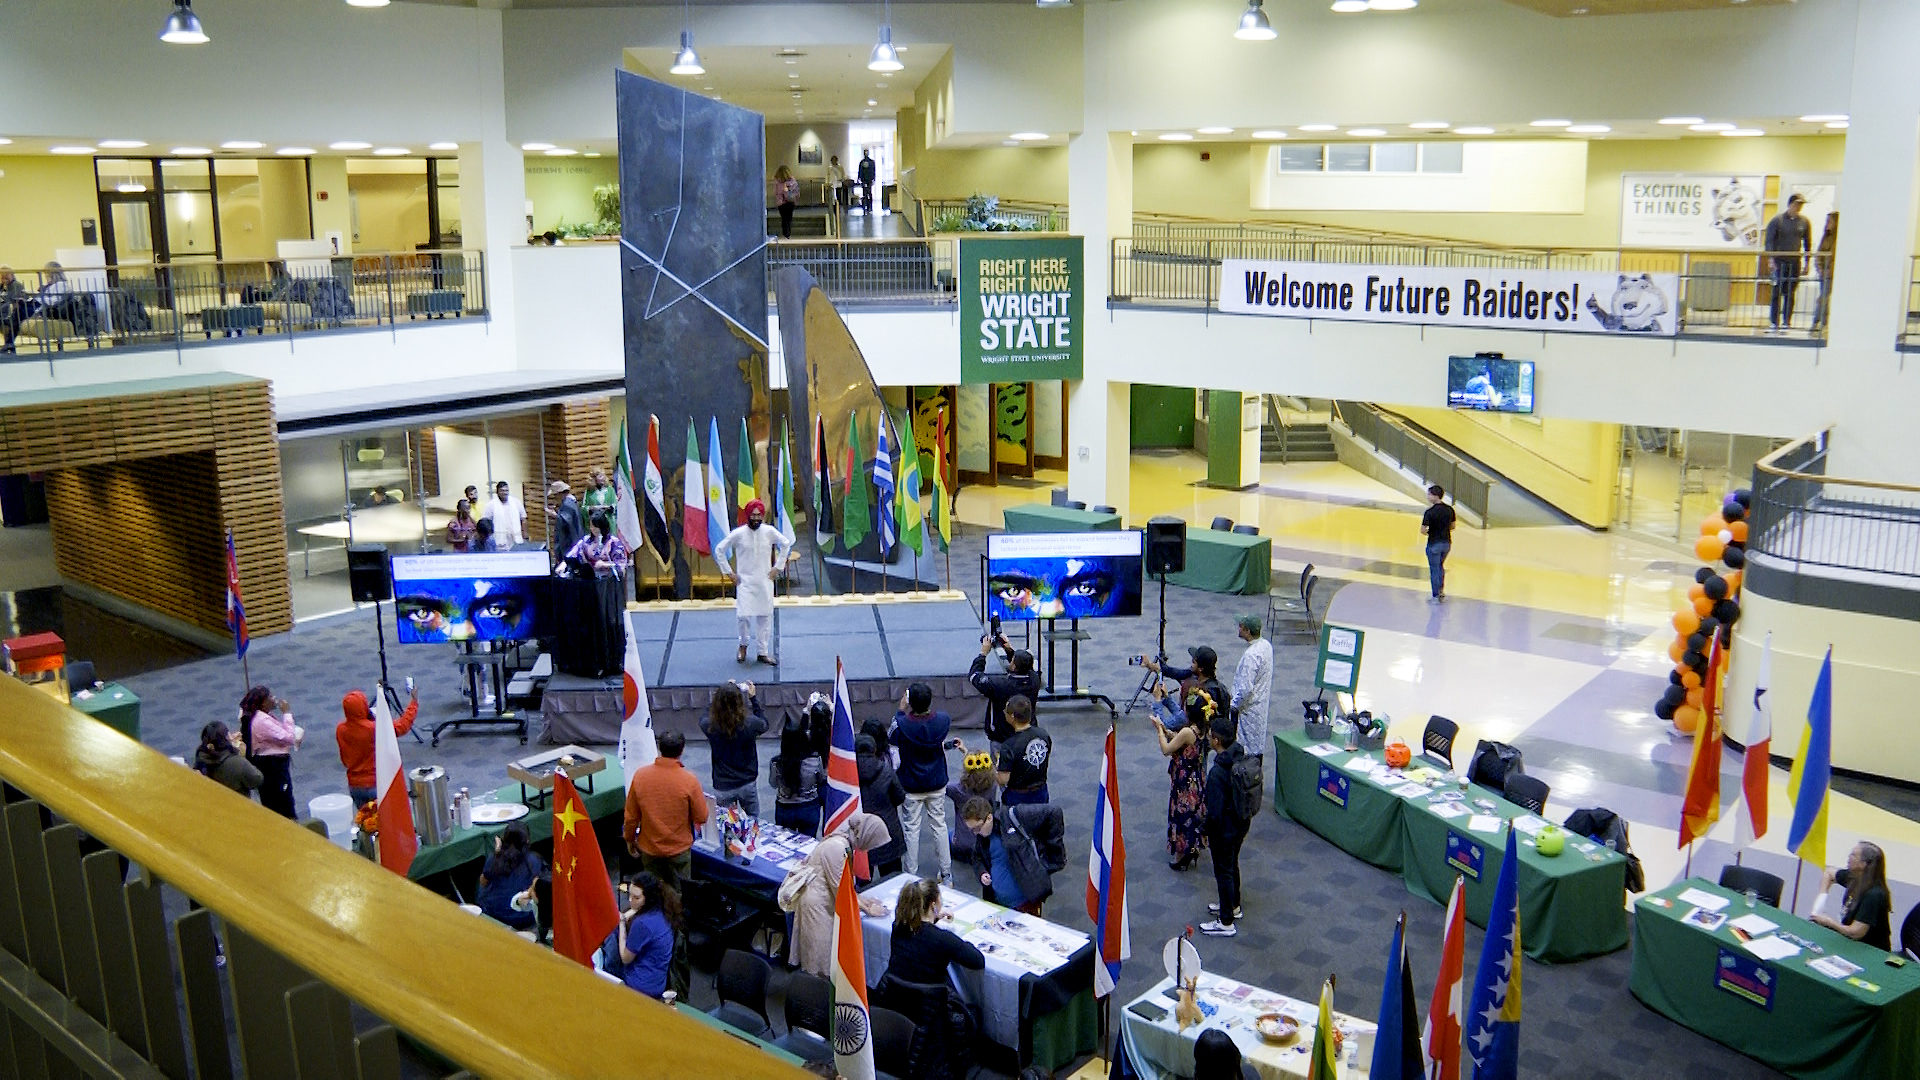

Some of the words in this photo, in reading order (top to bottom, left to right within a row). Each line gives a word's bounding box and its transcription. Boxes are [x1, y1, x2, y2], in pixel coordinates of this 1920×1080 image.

[1633, 184, 1702, 198] EXCITING
[1633, 201, 1702, 216] THINGS
[979, 259, 1027, 276] RIGHT
[1030, 257, 1071, 274] HERE.
[979, 276, 1027, 294] RIGHT
[1030, 275, 1071, 292] NOW.
[980, 293, 1071, 318] WRIGHT
[1245, 271, 1353, 310] Welcome
[1365, 275, 1450, 316] Future
[1463, 279, 1579, 321] Raiders!
[980, 317, 1071, 350] STATE
[981, 355, 1009, 363] WRIGHT
[1031, 353, 1070, 362] UNIVERSITY
